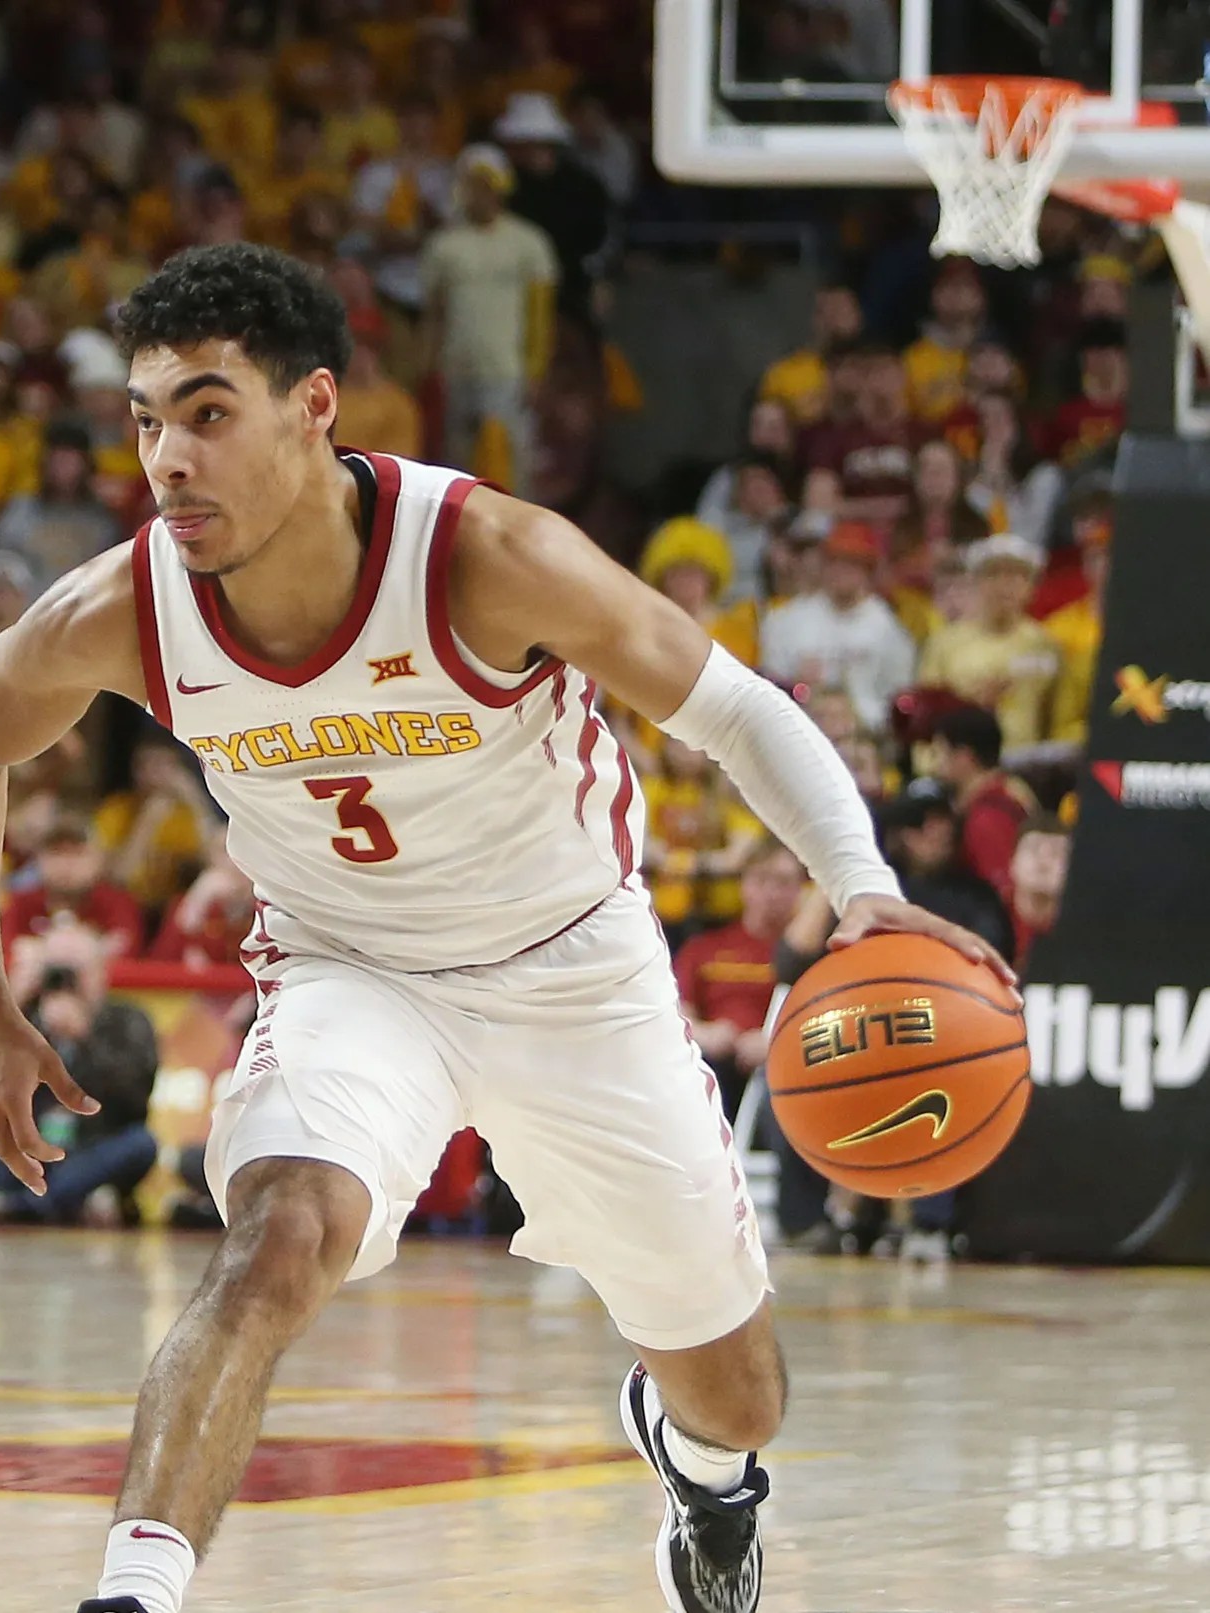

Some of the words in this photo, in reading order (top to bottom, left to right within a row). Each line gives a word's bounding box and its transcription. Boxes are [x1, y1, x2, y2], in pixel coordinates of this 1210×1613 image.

[366, 651, 421, 686] XII
[189, 711, 482, 773] CYCLONES
[301, 775, 399, 864] 3
[801, 1008, 935, 1068] ELITE
